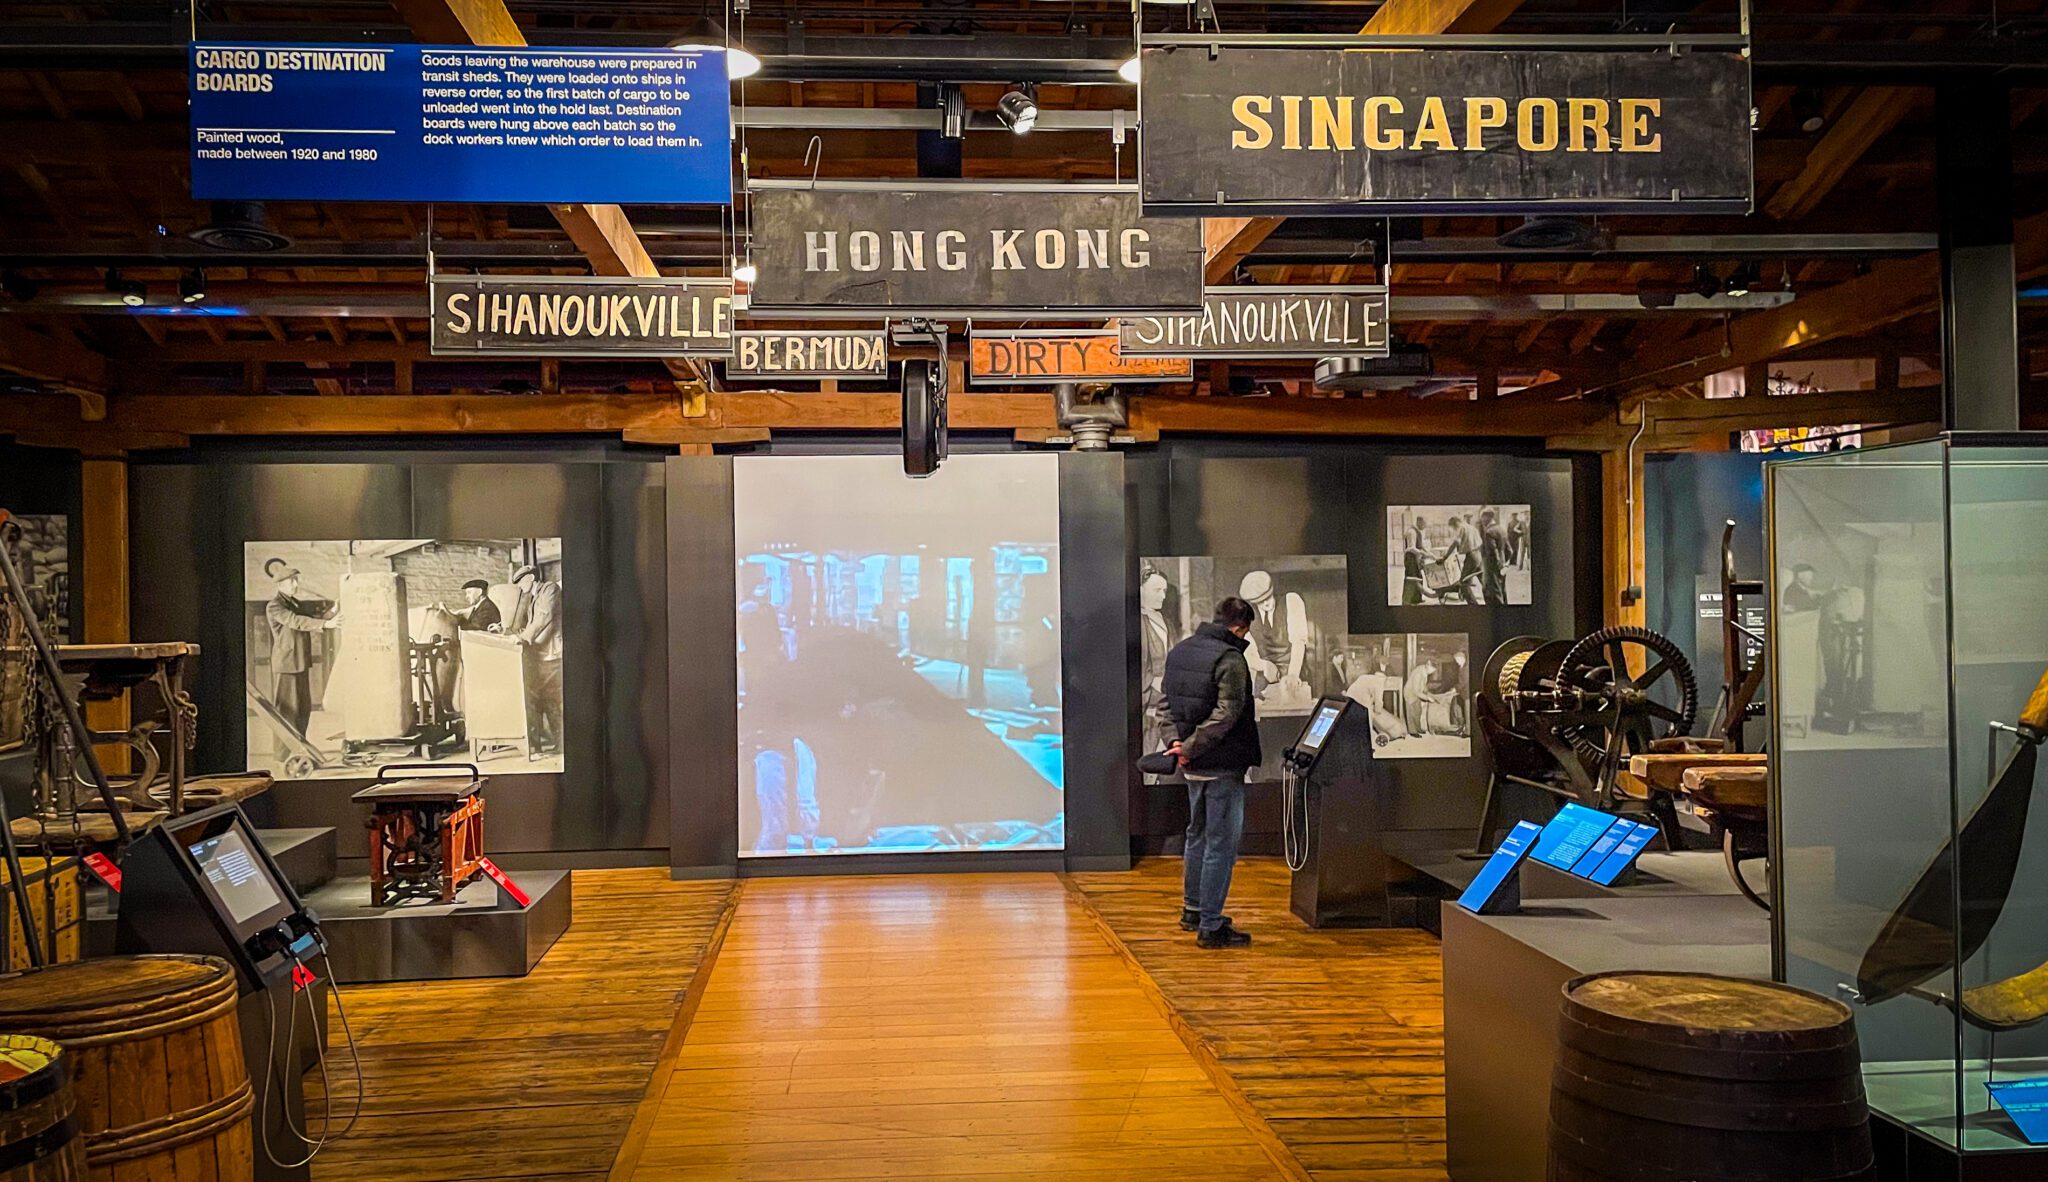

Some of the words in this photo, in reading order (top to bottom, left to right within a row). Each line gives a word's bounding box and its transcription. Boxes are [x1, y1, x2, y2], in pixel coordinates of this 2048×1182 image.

[196, 50, 259, 70] CARGO
[265, 52, 386, 72] DESTINATION
[422, 54, 462, 67] Goods
[465, 55, 507, 69] leaving
[510, 56, 528, 67] the
[532, 56, 596, 69] warehouse
[599, 59, 627, 69] were
[630, 57, 683, 73] prepared
[686, 58, 697, 70] in
[196, 73, 273, 92] BOARDS
[422, 70, 459, 82] transit
[463, 71, 502, 83] sheds.
[505, 71, 533, 86] They
[537, 74, 565, 84] were
[569, 72, 609, 84] loaded
[612, 74, 638, 85] onto
[641, 73, 673, 88] ships
[675, 74, 686, 85] in
[422, 88, 466, 98] reverse
[469, 87, 504, 100] order,
[507, 89, 521, 99] so
[524, 88, 543, 99] the
[546, 87, 569, 99] first
[572, 88, 605, 100] batch
[608, 88, 621, 100] of
[623, 91, 657, 103] cargo
[660, 90, 672, 101] to
[675, 89, 690, 101] be
[423, 102, 478, 114] unloaded
[481, 103, 510, 114] went
[513, 103, 535, 114] into
[538, 103, 557, 115] the
[560, 103, 586, 115] hold
[589, 104, 613, 115] last.
[617, 104, 682, 116] Destination
[423, 117, 465, 129] boards
[468, 120, 497, 129] were
[500, 118, 530, 132] hung
[533, 119, 569, 130] above
[572, 119, 600, 131] each
[604, 120, 637, 131] batch
[640, 122, 654, 132] so
[657, 120, 676, 132] the
[1231, 94, 1662, 153] SINGAPORE
[197, 132, 243, 144] Painted
[247, 132, 284, 146] wood,
[423, 133, 453, 144] dock
[456, 133, 503, 145] workers
[506, 134, 538, 145] knew
[541, 134, 576, 146] which
[579, 135, 610, 146] order
[613, 136, 625, 147] to
[628, 135, 653, 147] load
[656, 135, 686, 147] them
[689, 136, 703, 147] in.
[197, 147, 232, 159] made
[235, 148, 287, 160] between
[291, 149, 319, 160] 1920
[323, 149, 345, 160] and
[349, 149, 378, 161] 1980
[804, 230, 968, 272] HONG
[990, 228, 1151, 270] KONG
[446, 293, 732, 339] SIHANOUKVILLE
[739, 336, 886, 371] BERMUDA
[988, 341, 1092, 374] DIRTY
